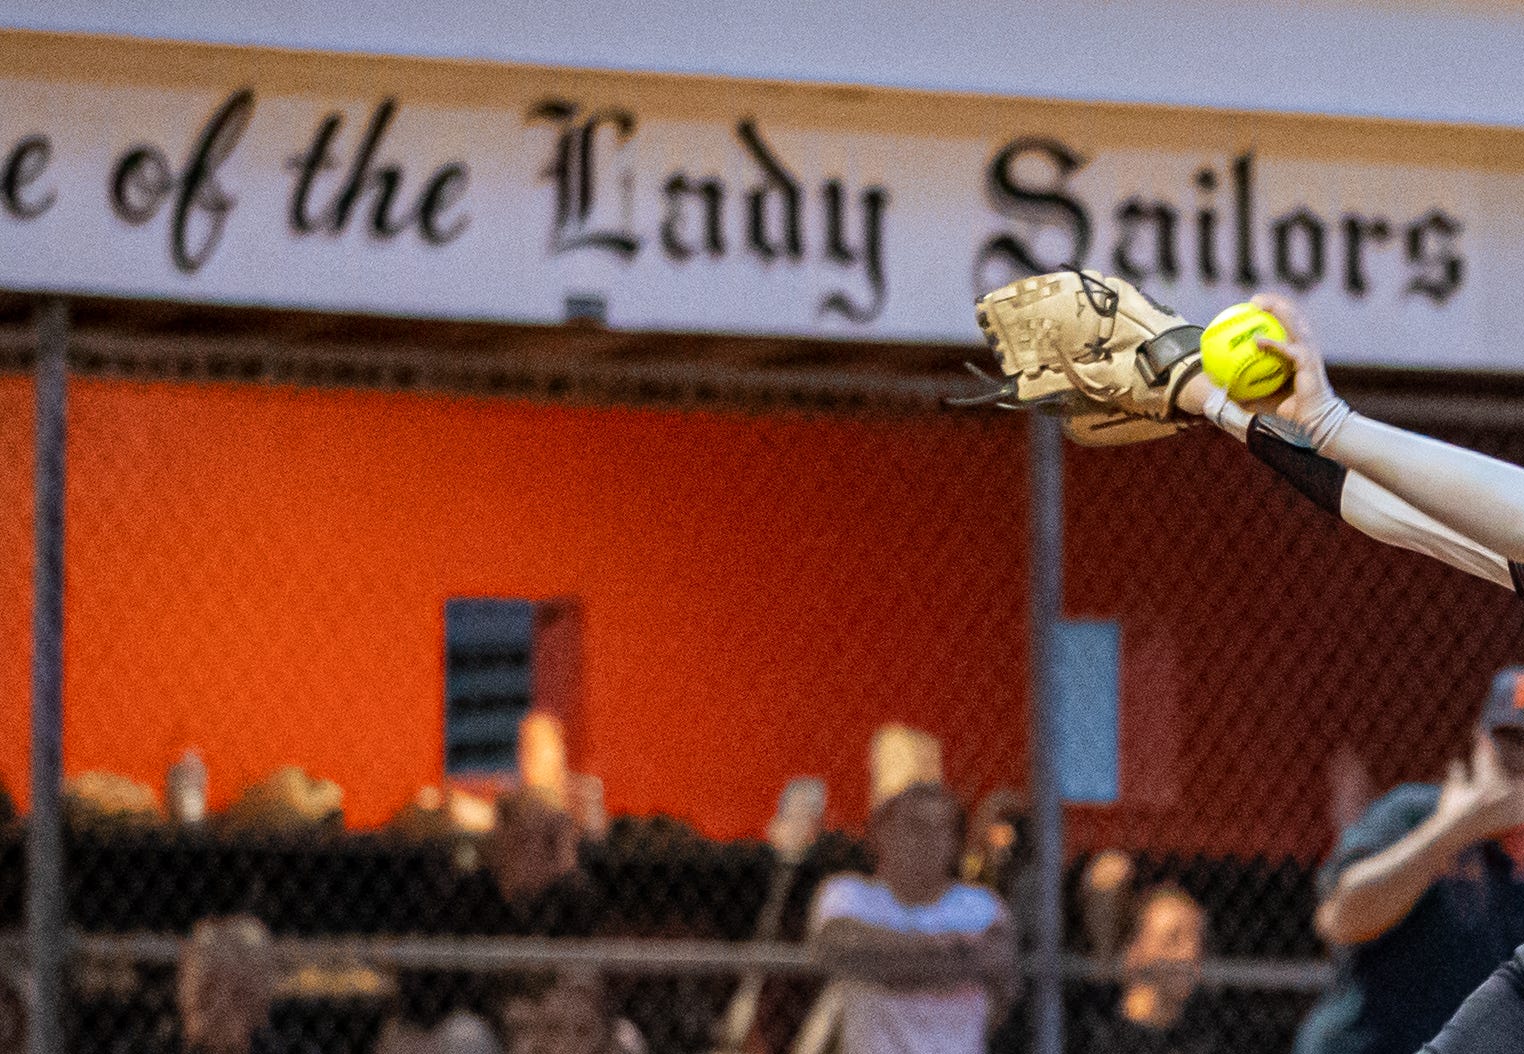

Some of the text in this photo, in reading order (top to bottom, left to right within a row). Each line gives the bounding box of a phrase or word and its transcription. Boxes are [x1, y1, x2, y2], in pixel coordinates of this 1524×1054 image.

[108, 87, 256, 275] of
[286, 97, 471, 246] the
[526, 96, 892, 323] Lady
[975, 133, 1468, 304] Sailors
